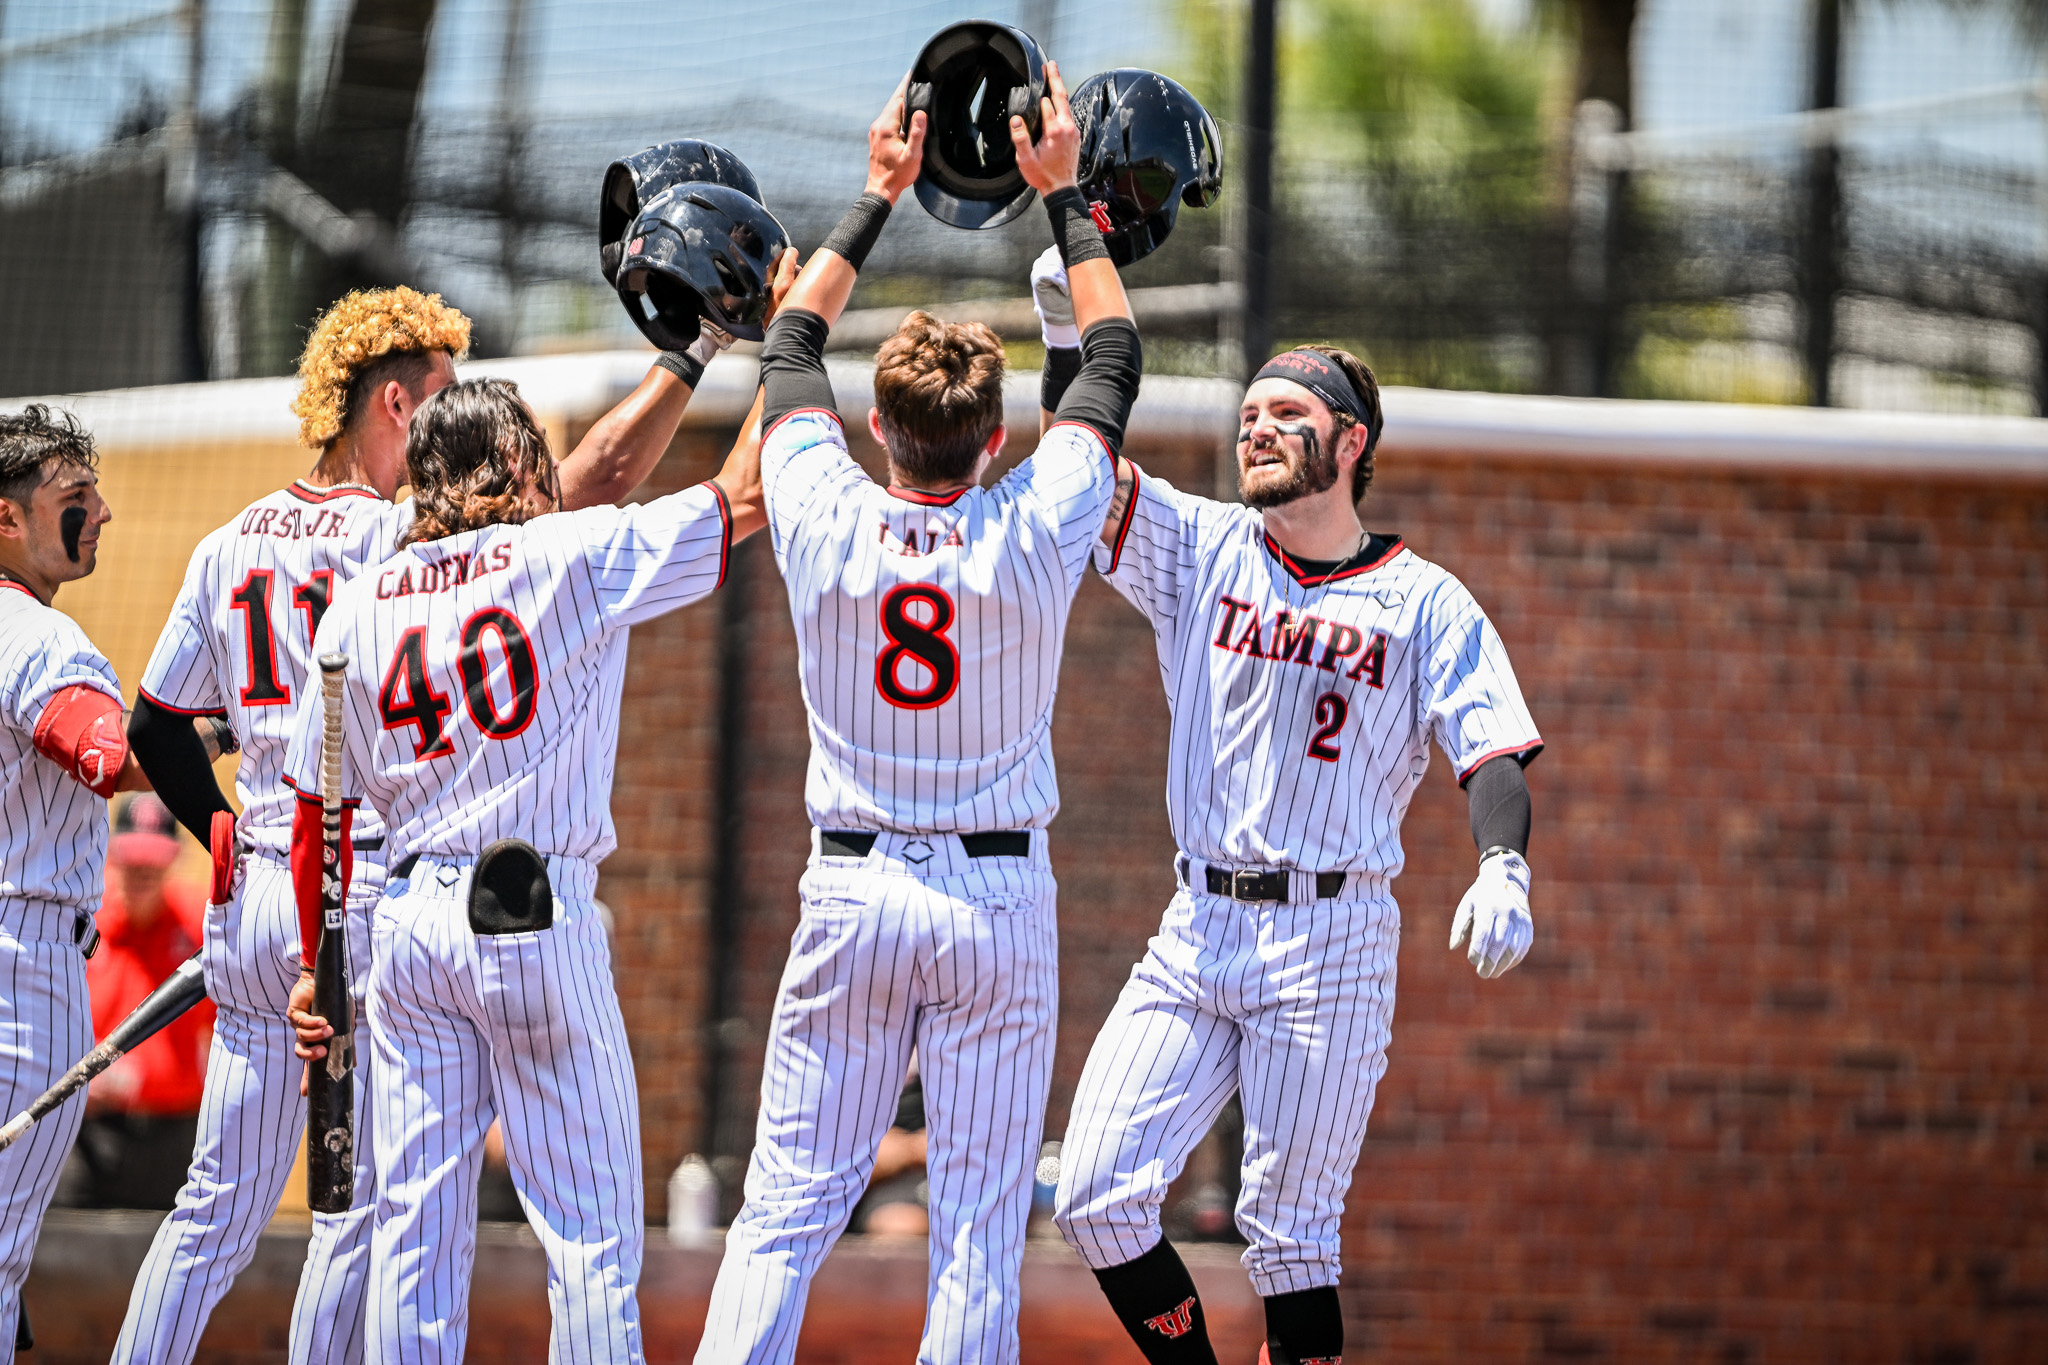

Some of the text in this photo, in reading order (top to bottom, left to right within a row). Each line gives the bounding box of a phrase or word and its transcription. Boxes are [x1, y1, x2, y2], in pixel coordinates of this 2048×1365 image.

[240, 508, 302, 541] URSO
[376, 542, 512, 600] CADENAS
[229, 568, 334, 707] 11
[378, 605, 540, 762] 40
[875, 581, 960, 710] 8
[1213, 594, 1387, 690] TAMPA
[1307, 691, 1348, 762] 2
